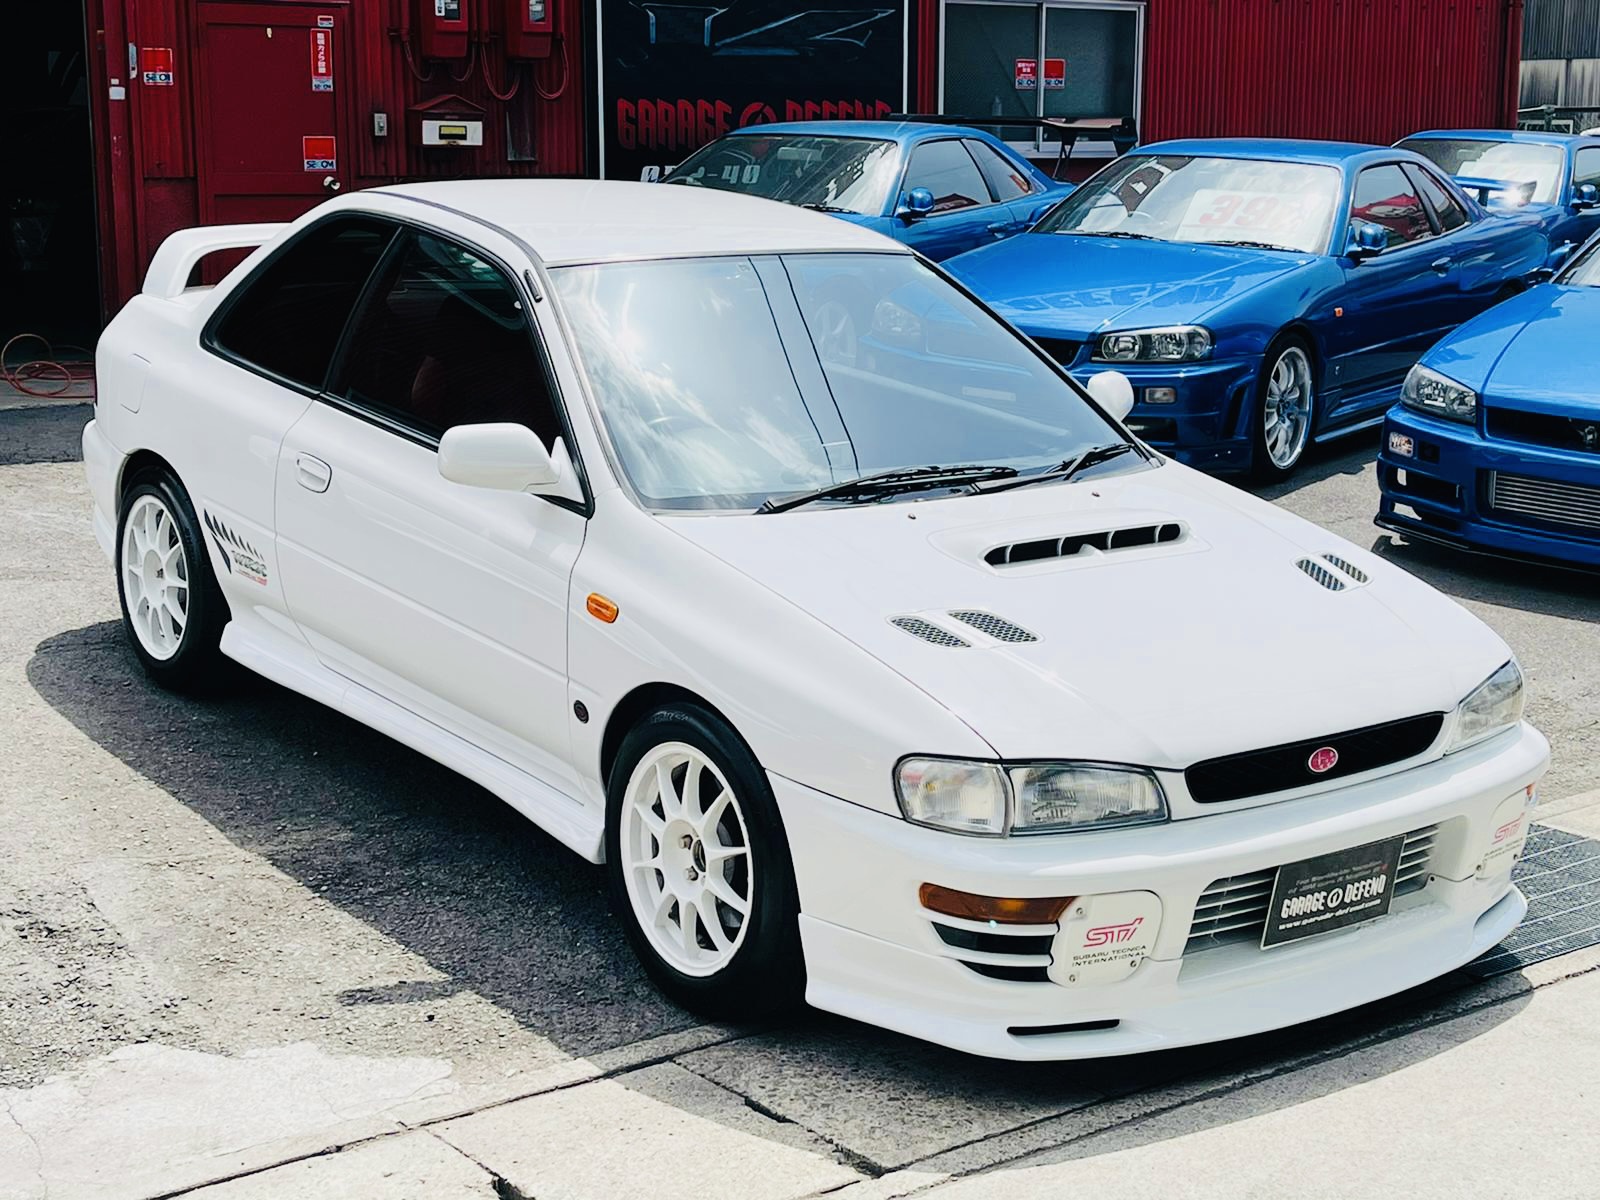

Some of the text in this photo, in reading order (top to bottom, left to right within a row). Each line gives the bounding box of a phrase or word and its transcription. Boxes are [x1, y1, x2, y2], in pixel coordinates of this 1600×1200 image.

[616, 97, 733, 151] GARAGE
[1280, 890, 1328, 919] GARAGE
[1343, 874, 1387, 904] DEFEND
[1071, 952, 1146, 967] INTERNATIONAL
[1073, 944, 1147, 961] SUBARU TECNICA
